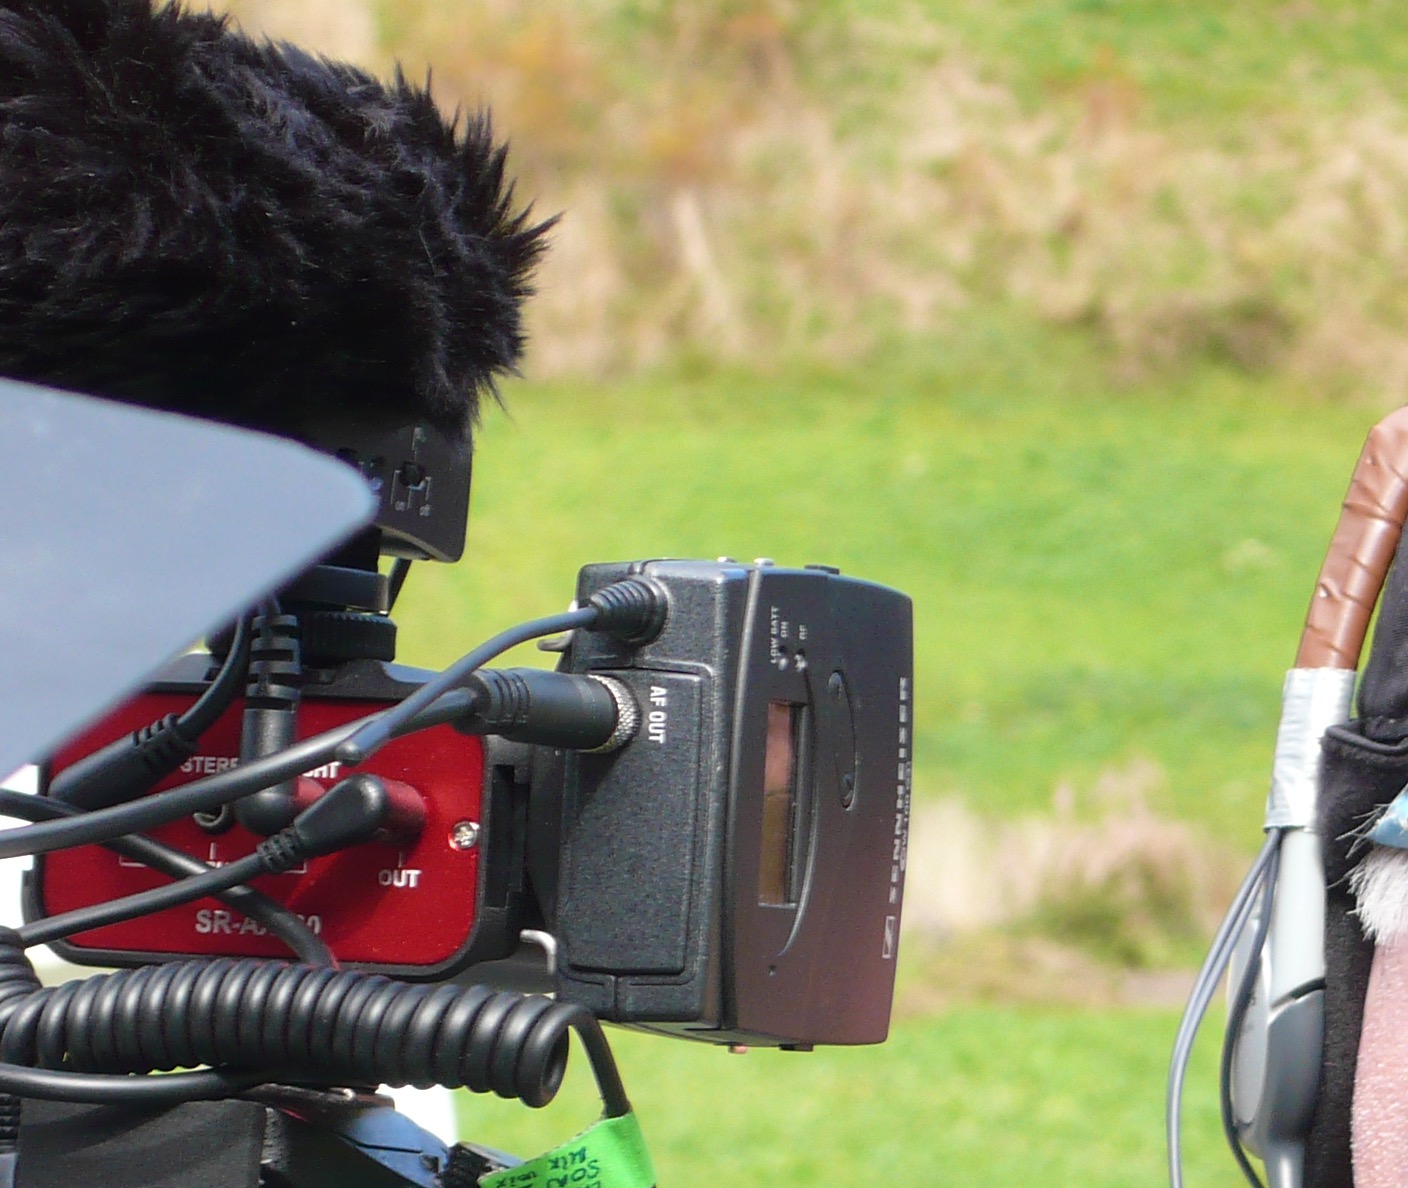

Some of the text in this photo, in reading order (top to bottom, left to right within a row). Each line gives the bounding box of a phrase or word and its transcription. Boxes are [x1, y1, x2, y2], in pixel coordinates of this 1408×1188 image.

[770, 605, 781, 635] BATT
[647, 686, 667, 744] AF OUT
[378, 868, 422, 889] OUT
